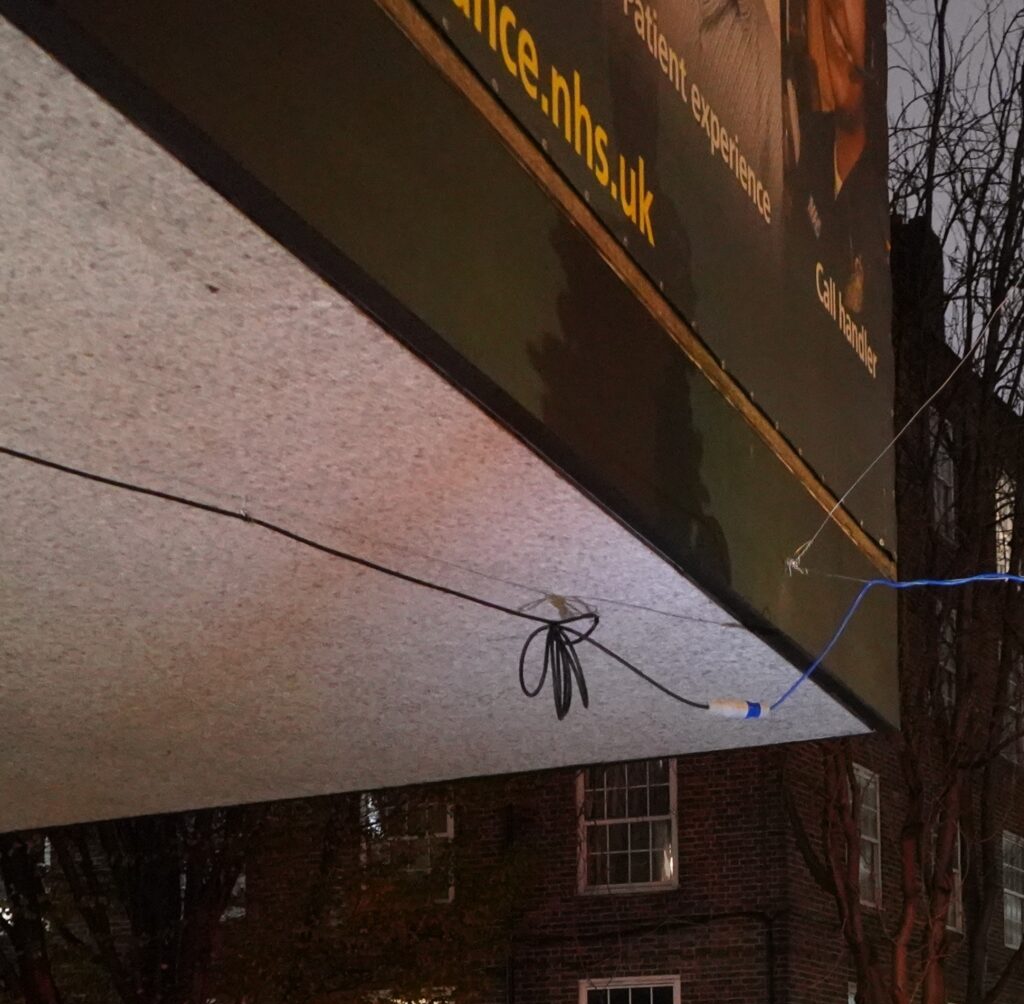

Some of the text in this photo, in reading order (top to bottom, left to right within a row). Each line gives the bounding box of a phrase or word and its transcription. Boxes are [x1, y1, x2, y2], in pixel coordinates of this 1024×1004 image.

[453, 0, 656, 247] nce.nhs.uk
[623, 0, 773, 225] atient experience
[815, 261, 878, 379] Call handler
